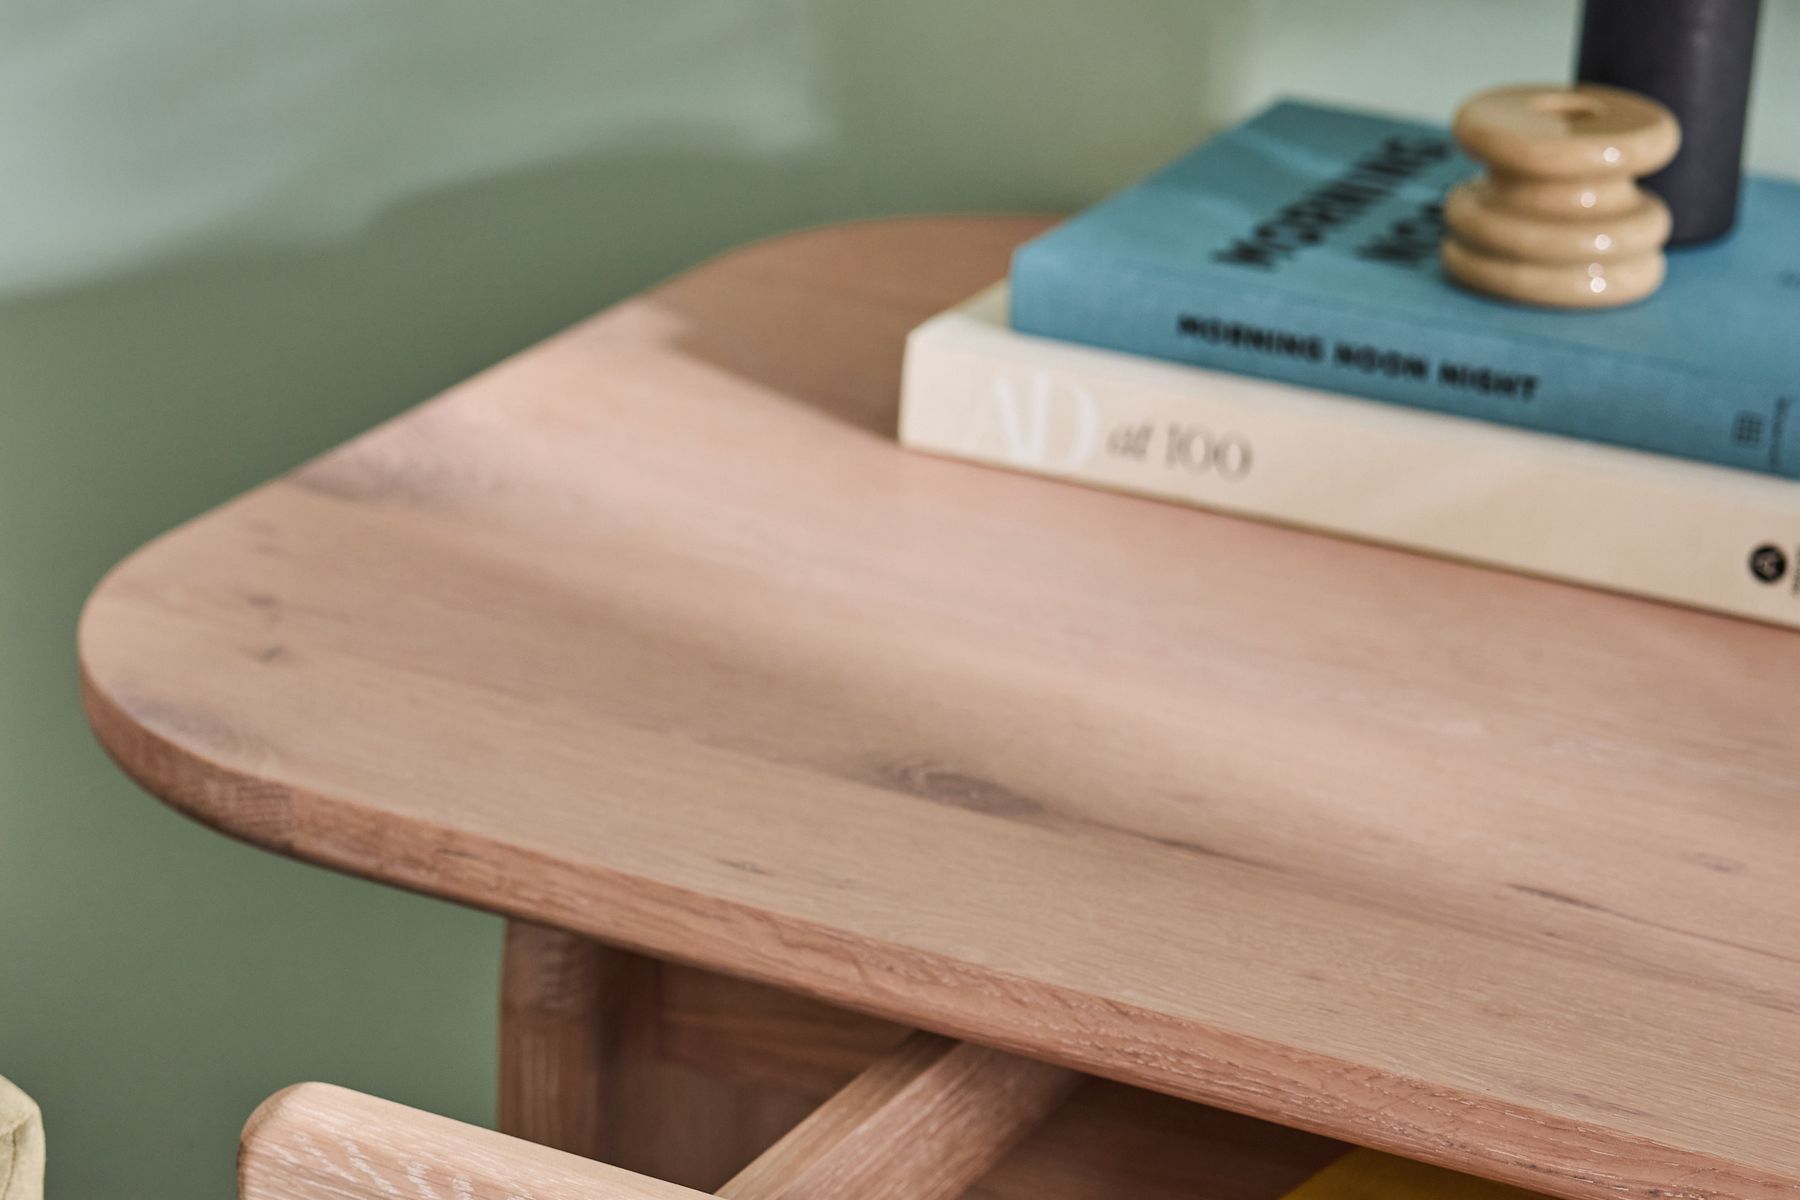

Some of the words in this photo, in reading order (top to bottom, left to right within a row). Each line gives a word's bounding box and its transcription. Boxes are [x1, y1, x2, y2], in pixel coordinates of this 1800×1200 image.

[1178, 313, 1324, 363] MORNING
[1334, 341, 1429, 381] NOON
[1438, 359, 1540, 402] NIGHT
[1165, 421, 1254, 484] 100
